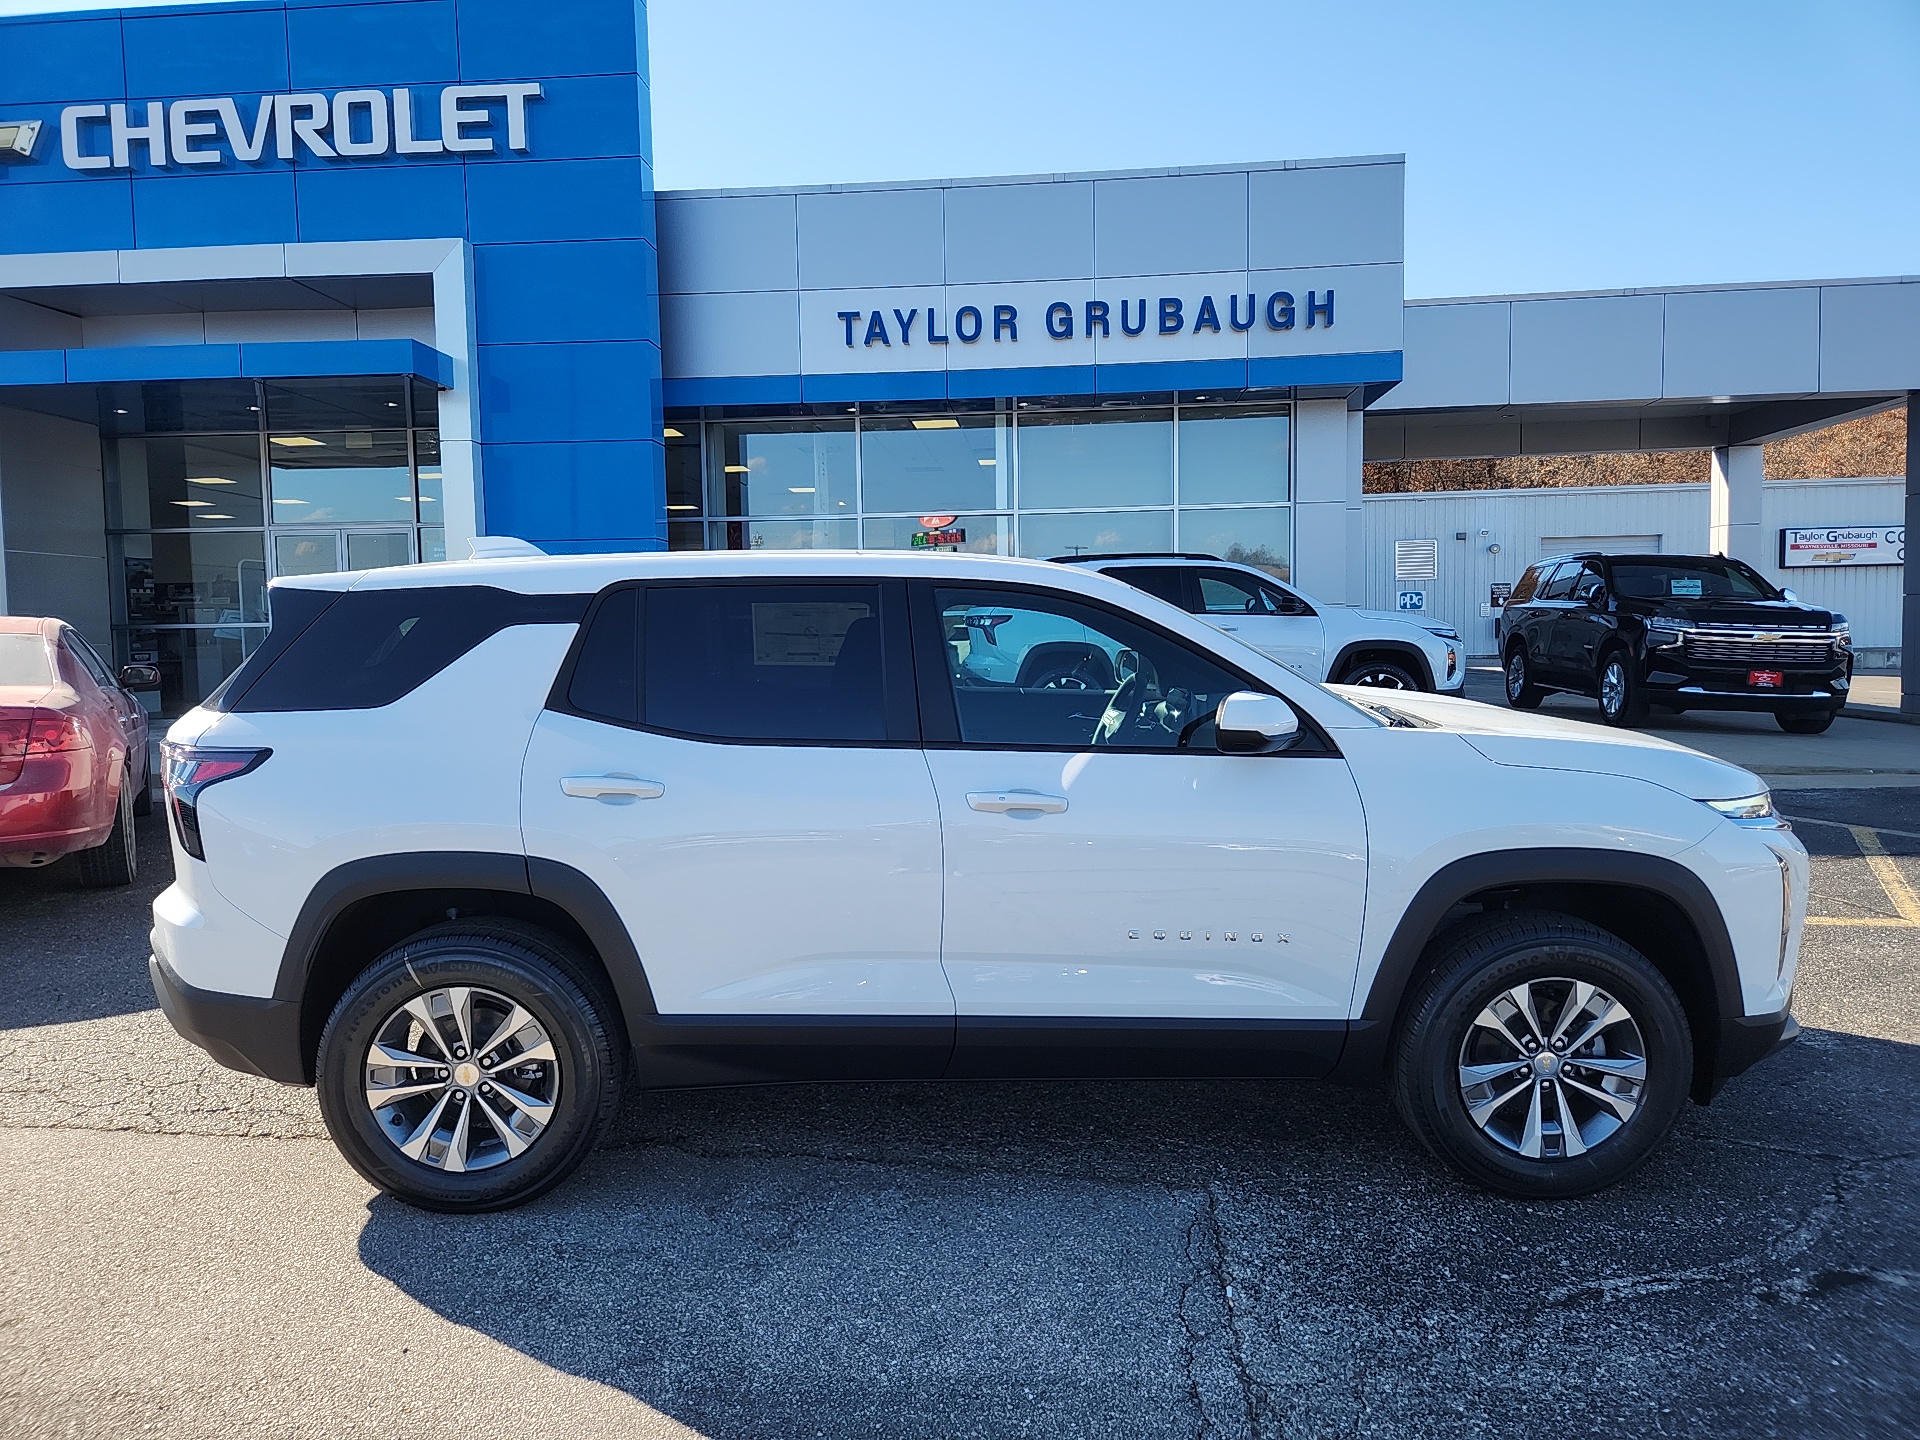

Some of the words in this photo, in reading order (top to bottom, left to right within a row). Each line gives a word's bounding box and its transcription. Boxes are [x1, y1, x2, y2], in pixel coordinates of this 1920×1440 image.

[60, 82, 543, 170] CHEVROLET
[837, 304, 1018, 348] TAYLOR
[1045, 289, 1336, 341] GRUBAUGH
[1789, 531, 1825, 543] Taylor
[1826, 529, 1878, 543] Grubaugh
[1400, 593, 1423, 609] PPG
[1127, 929, 1291, 944] EQUINOX
